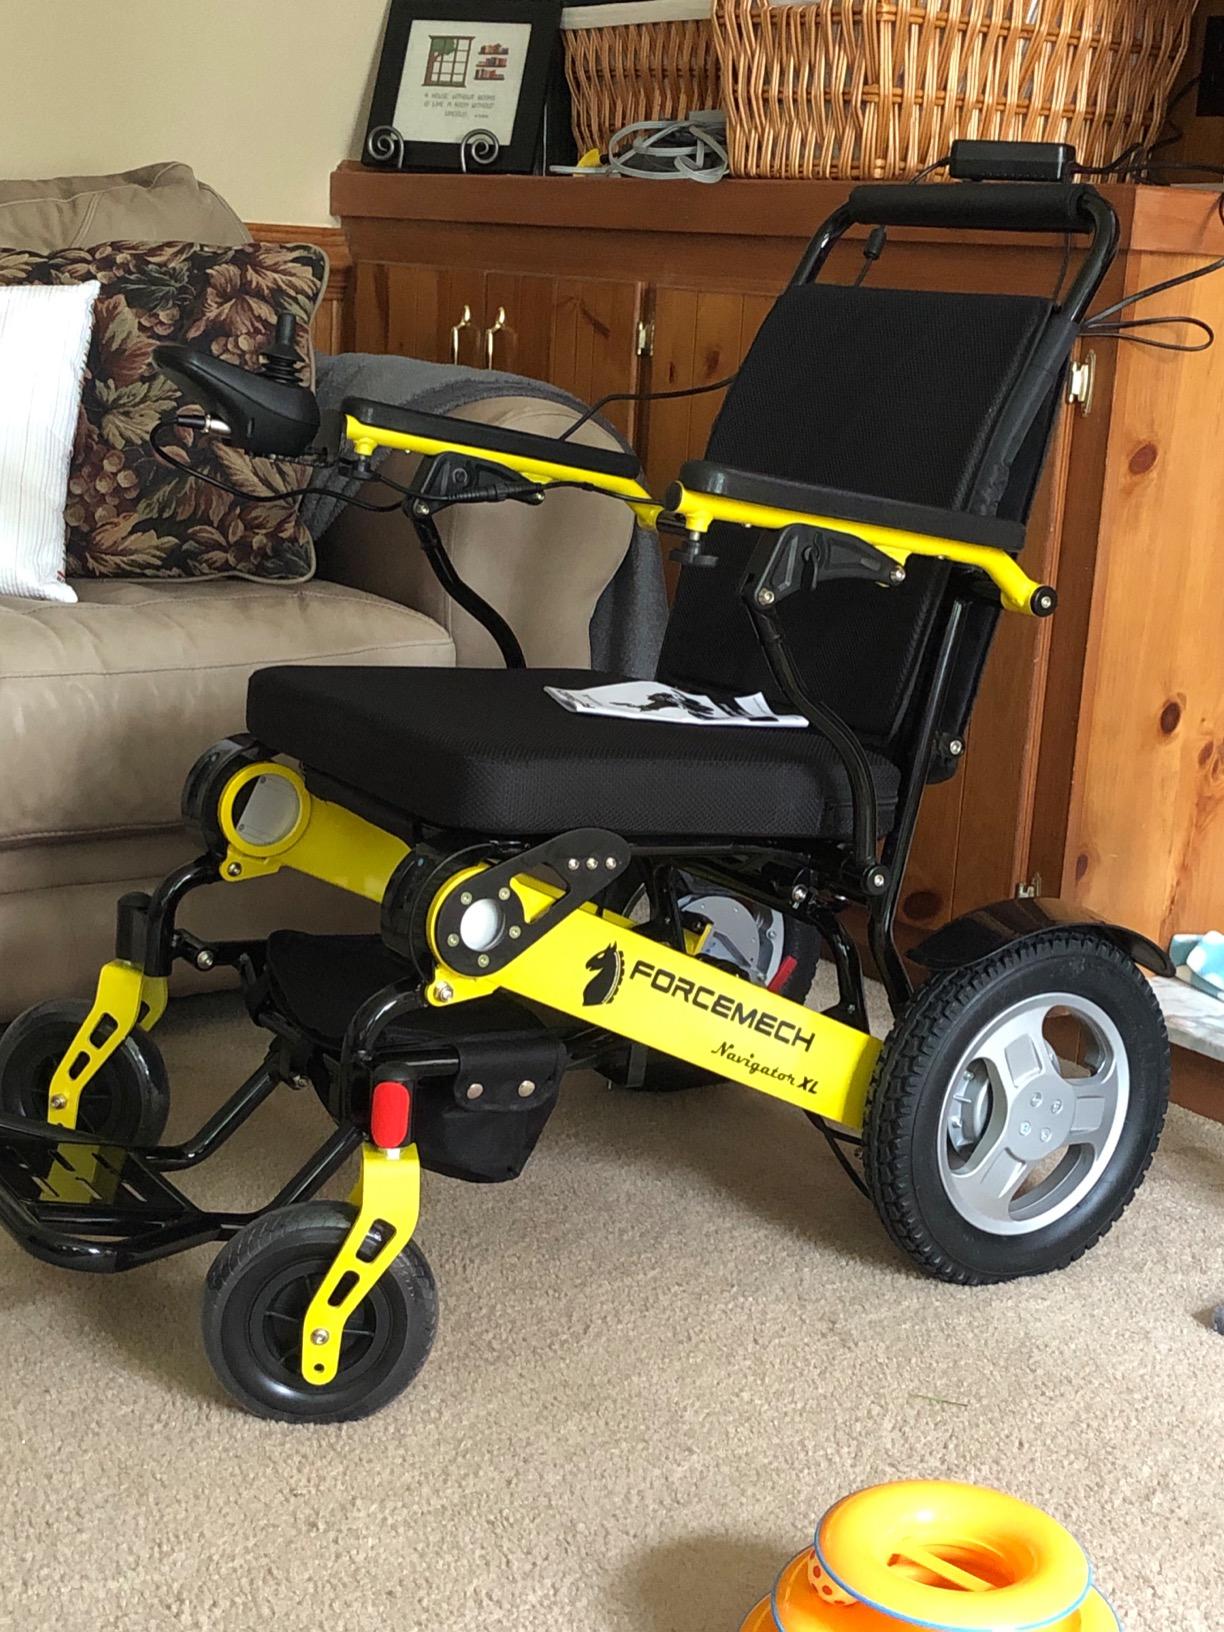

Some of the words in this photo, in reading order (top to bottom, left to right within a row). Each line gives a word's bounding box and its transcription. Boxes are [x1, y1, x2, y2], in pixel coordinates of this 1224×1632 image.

[630, 960, 816, 1052] FORCEMECH
[711, 1041, 796, 1086] Navigator
[797, 1076, 820, 1094] XL
